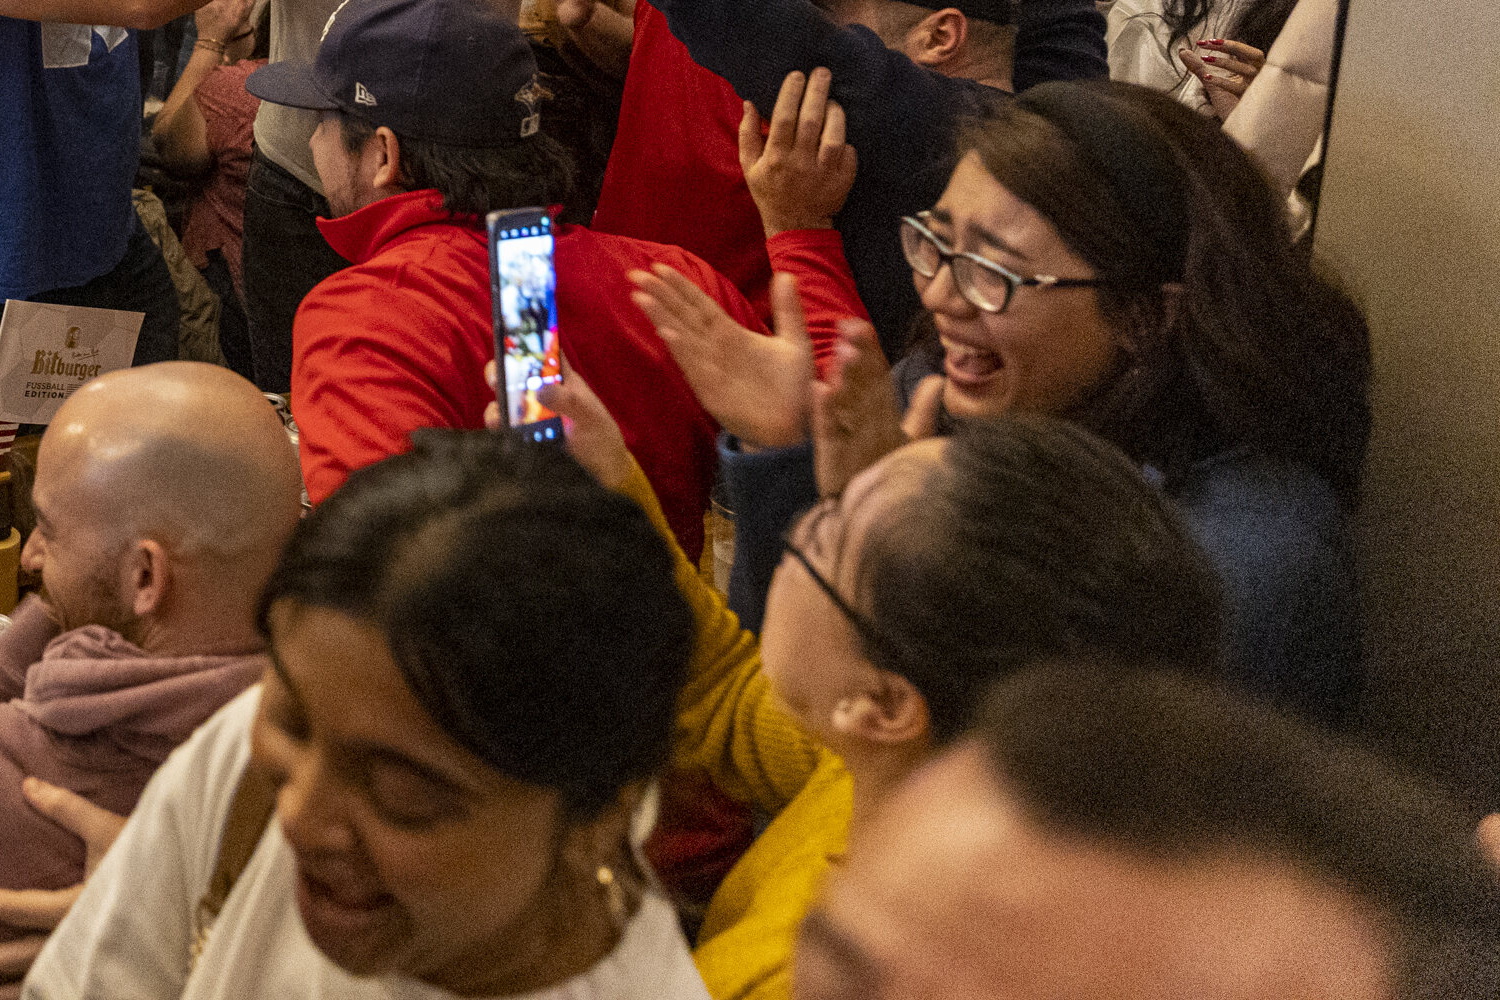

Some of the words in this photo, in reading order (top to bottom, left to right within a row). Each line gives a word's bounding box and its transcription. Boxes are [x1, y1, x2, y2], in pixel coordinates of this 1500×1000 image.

[30, 349, 102, 380] Bitburger
[26, 381, 65, 391] FUSSBALL
[24, 390, 65, 399] EDITION
